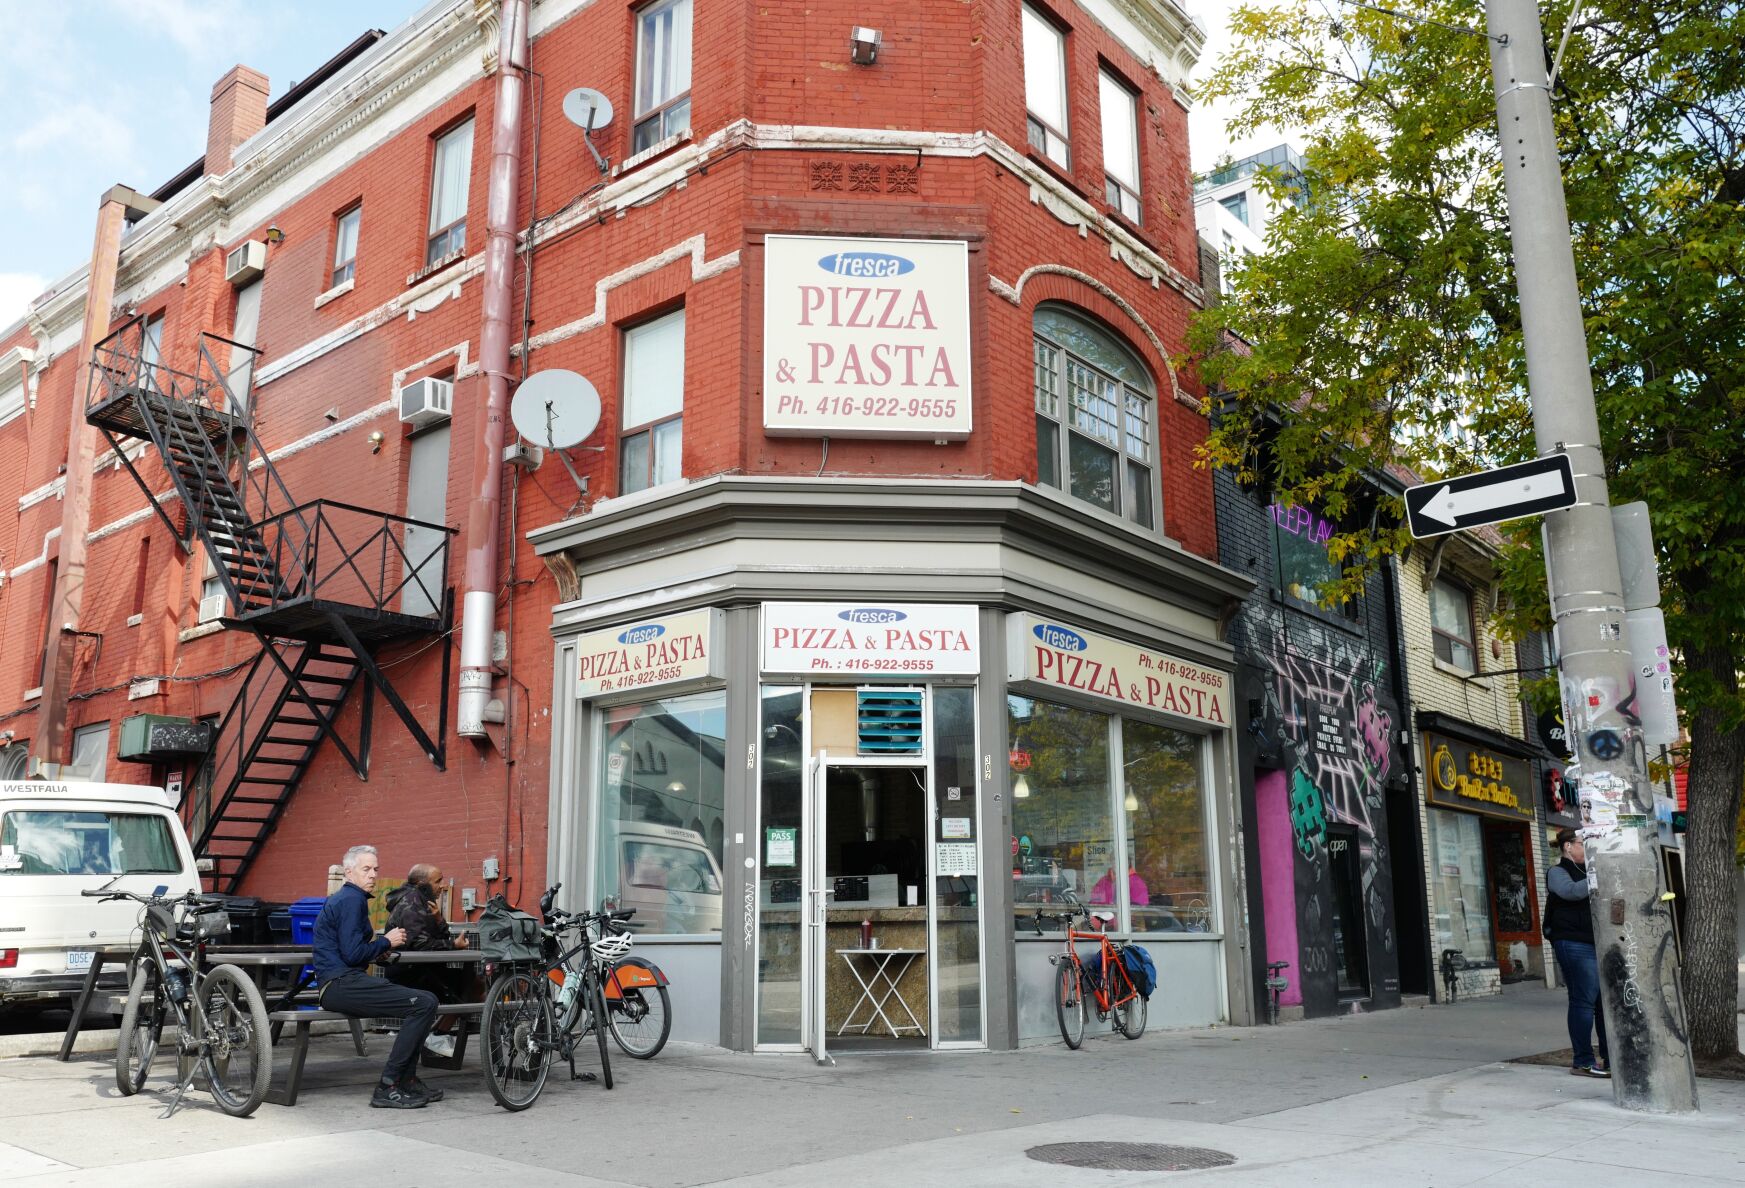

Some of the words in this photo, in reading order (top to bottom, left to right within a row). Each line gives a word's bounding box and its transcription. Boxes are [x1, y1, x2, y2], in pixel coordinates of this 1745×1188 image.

[834, 253, 900, 277] fresca
[797, 285, 938, 330] PIZZA
[775, 358, 796, 384] &
[807, 342, 960, 388] PASTA
[777, 395, 808, 415] Ph.
[816, 396, 957, 418] 416-922-9555
[848, 608, 898, 624] fresca
[624, 625, 660, 645] fresca
[772, 627, 857, 650] PIZZA
[864, 635, 877, 650] &
[885, 629, 971, 652] PASTA
[1042, 624, 1080, 651] fresca
[579, 648, 630, 681] PIZZA
[633, 655, 643, 669] &
[644, 633, 707, 668] PASTA
[845, 658, 934, 671] 416-922-9555
[600, 679, 615, 692] Ph.
[616, 665, 682, 689] 416-922-9555
[1138, 653, 1154, 670] Ph.
[1157, 659, 1223, 689] 416-922-9555
[1034, 645, 1126, 700] PIZZA
[1130, 683, 1142, 702] &
[1145, 676, 1225, 723] PASTA
[3, 784, 68, 794] WESTFALIA
[771, 832, 791, 841] PASS
[1330, 839, 1347, 859] open
[69, 953, 89, 964] DDSE
